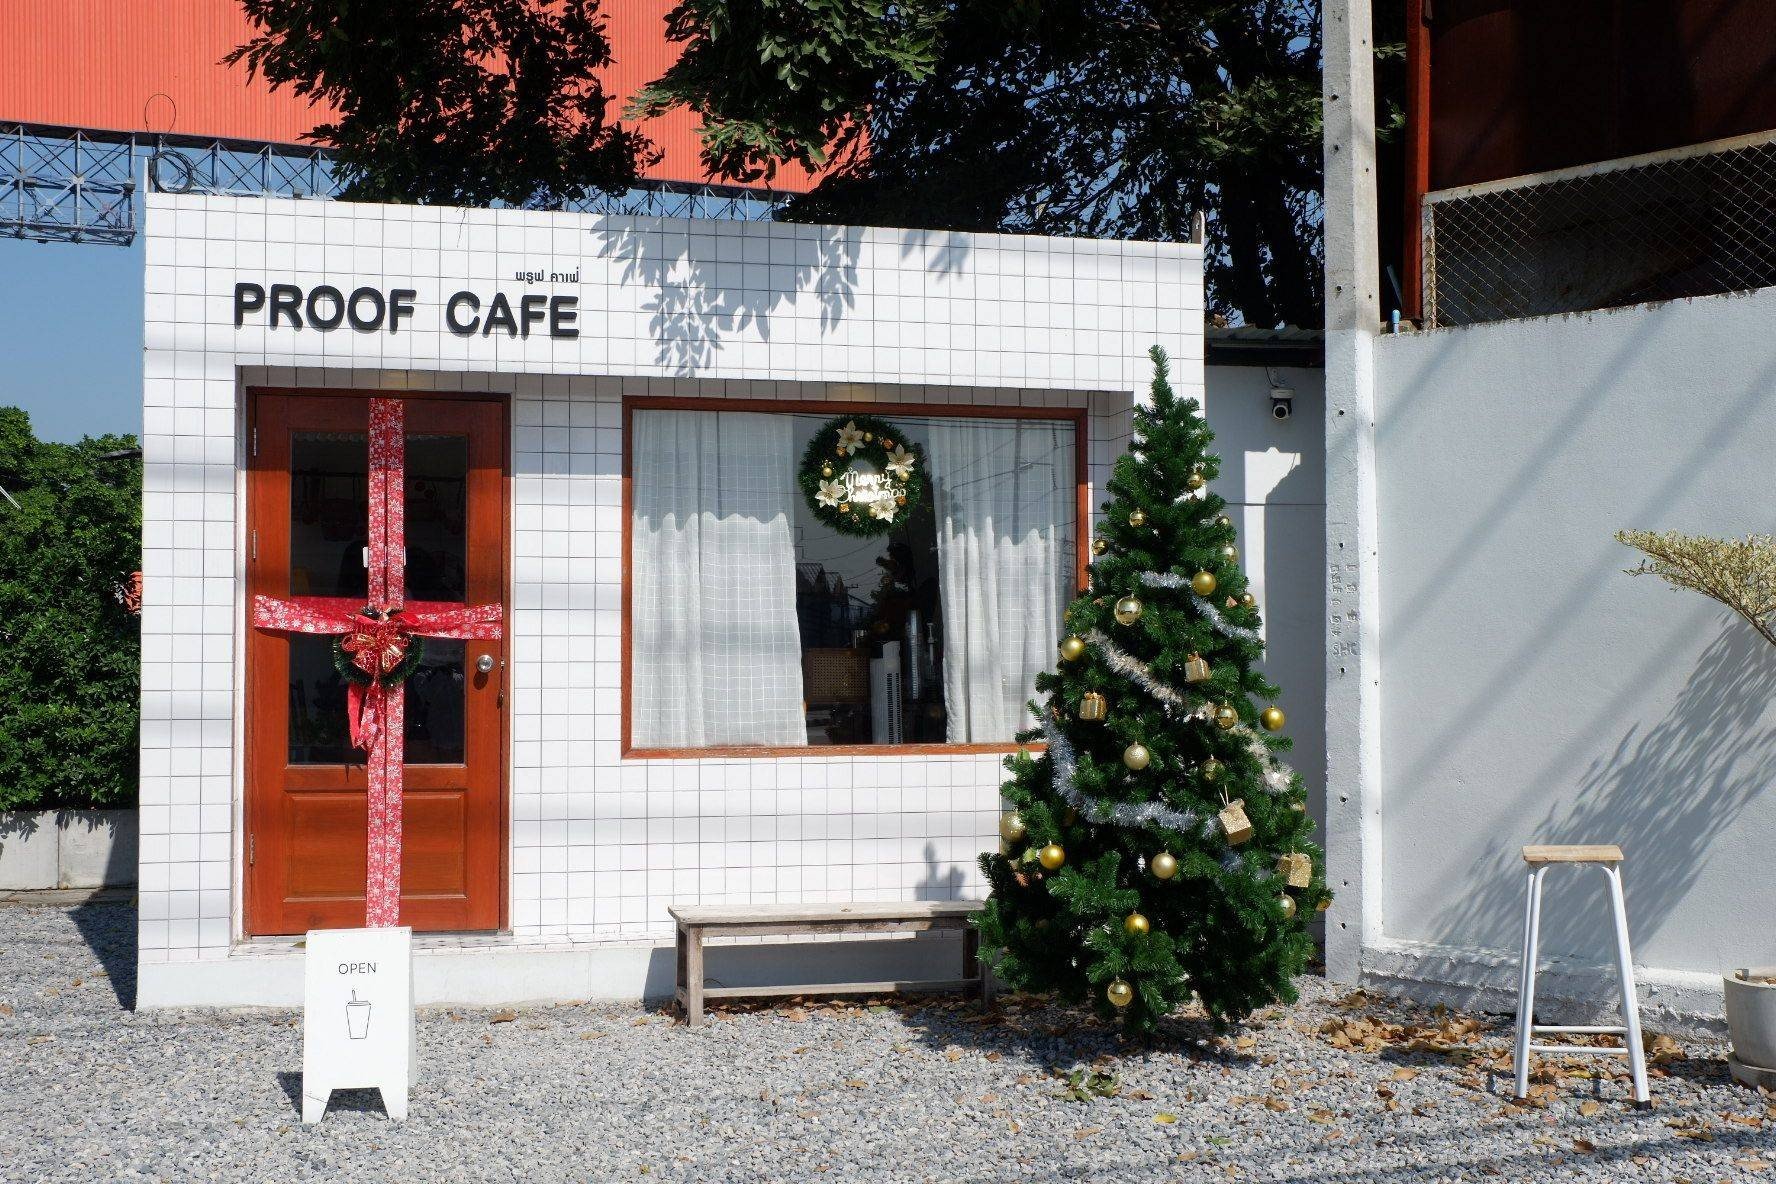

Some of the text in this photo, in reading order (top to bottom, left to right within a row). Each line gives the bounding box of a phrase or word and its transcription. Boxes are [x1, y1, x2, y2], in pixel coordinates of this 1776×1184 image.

[515, 266, 579, 285] พรูฟ คาเฟ่
[234, 282, 580, 339] PROOF CAFE
[338, 962, 377, 975] OPEN
